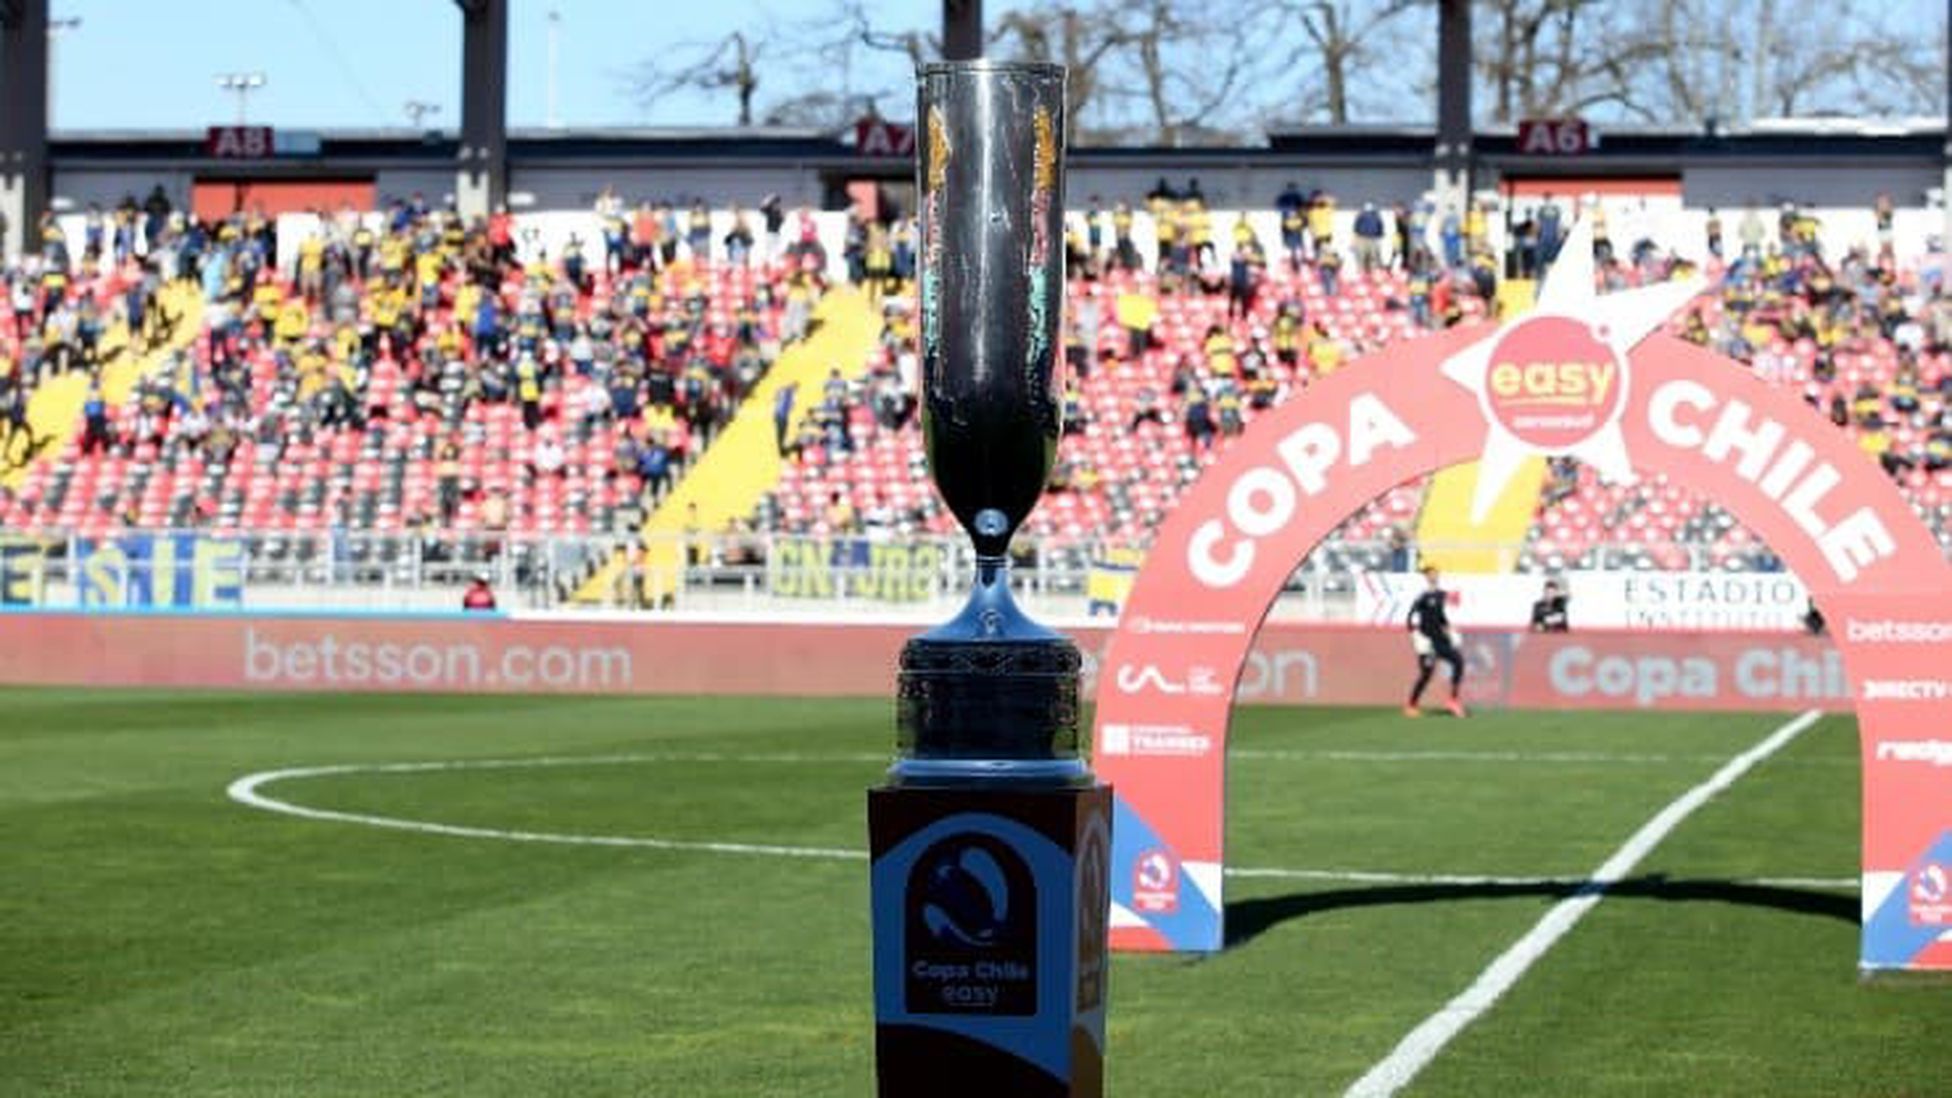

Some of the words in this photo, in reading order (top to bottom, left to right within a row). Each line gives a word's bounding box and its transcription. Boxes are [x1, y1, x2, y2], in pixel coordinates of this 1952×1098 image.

[1524, 124, 1581, 152] A6
[1491, 361, 1616, 406] easy
[1187, 392, 1417, 588] COPA
[1648, 380, 1898, 582] CHILE
[1625, 578, 1795, 604] ESTADIO
[244, 627, 633, 686] betsson.com
[1549, 645, 1717, 706] Copa
[912, 961, 969, 981] Copa
[975, 960, 1029, 980] Chile
